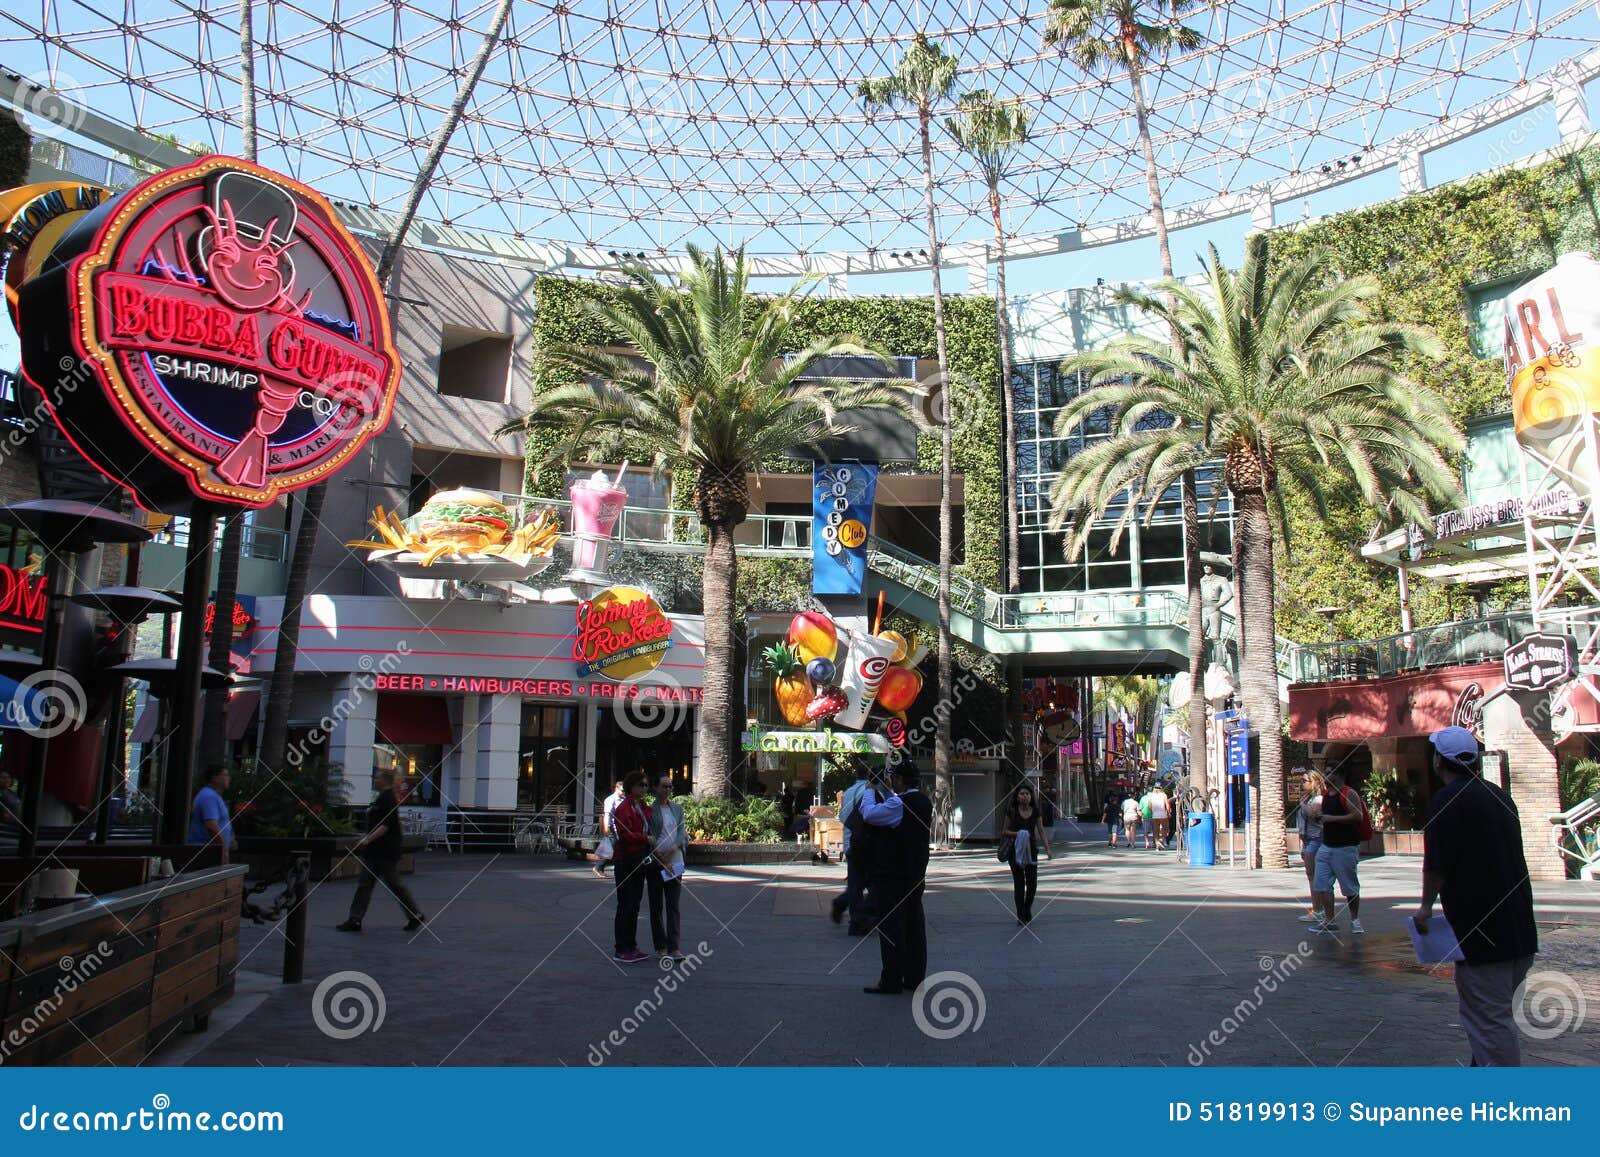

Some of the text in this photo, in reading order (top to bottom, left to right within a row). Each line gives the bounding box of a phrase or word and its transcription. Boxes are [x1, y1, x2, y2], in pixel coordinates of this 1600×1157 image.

[11, 190, 73, 244] HOWL
[111, 280, 384, 394] BUBBA GUMP
[153, 354, 259, 390] SHRIMP
[127, 351, 223, 456] RESTAURANT
[824, 469, 850, 553] COMEDY
[1437, 504, 1492, 537] STRAUSS
[841, 523, 864, 543] Club
[573, 594, 658, 661] Johnny
[586, 617, 673, 661] Rockets
[588, 662, 601, 672] THE
[632, 641, 669, 656] HAMBURGER
[376, 675, 425, 691] BEER
[443, 677, 573, 697] HAMBURGERS
[590, 684, 640, 700] FRIES
[742, 724, 872, 752] Jamba
